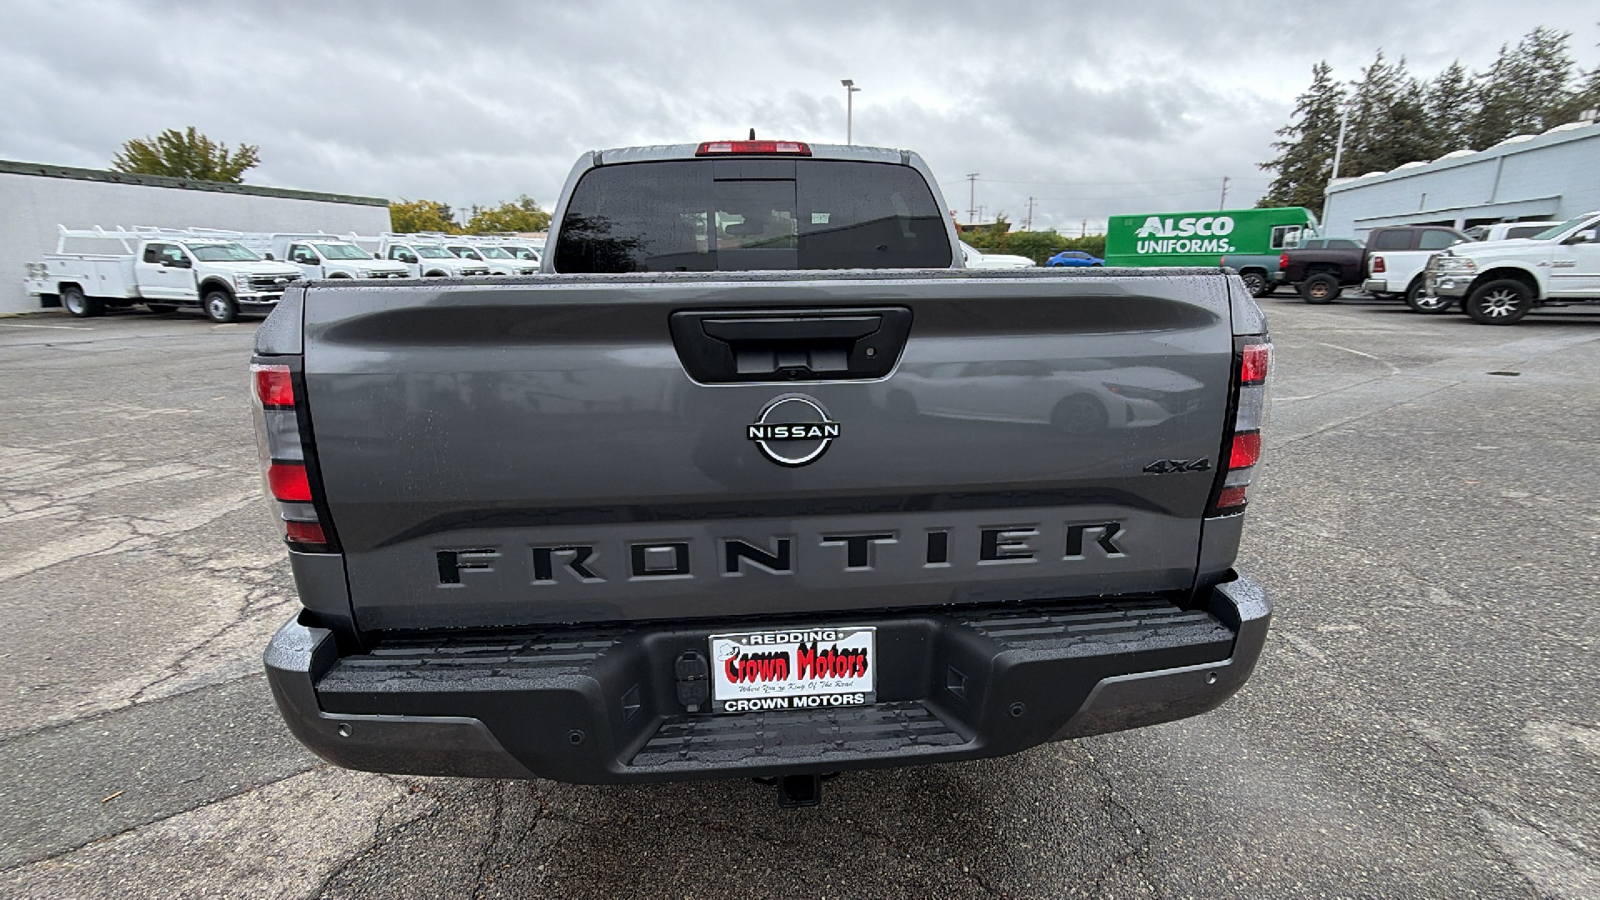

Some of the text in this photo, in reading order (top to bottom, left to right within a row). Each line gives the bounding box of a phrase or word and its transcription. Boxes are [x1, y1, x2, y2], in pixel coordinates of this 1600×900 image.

[1134, 216, 1235, 238] ALSCO
[749, 424, 839, 438] NISSAN
[436, 520, 1127, 587] FRONTIER
[751, 631, 836, 645] REDDING
[724, 643, 868, 684] Crown Motors
[738, 685, 760, 693] Where
[788, 683, 805, 692] King
[808, 682, 817, 690] Of
[724, 693, 865, 711] CROWN MOTORS
